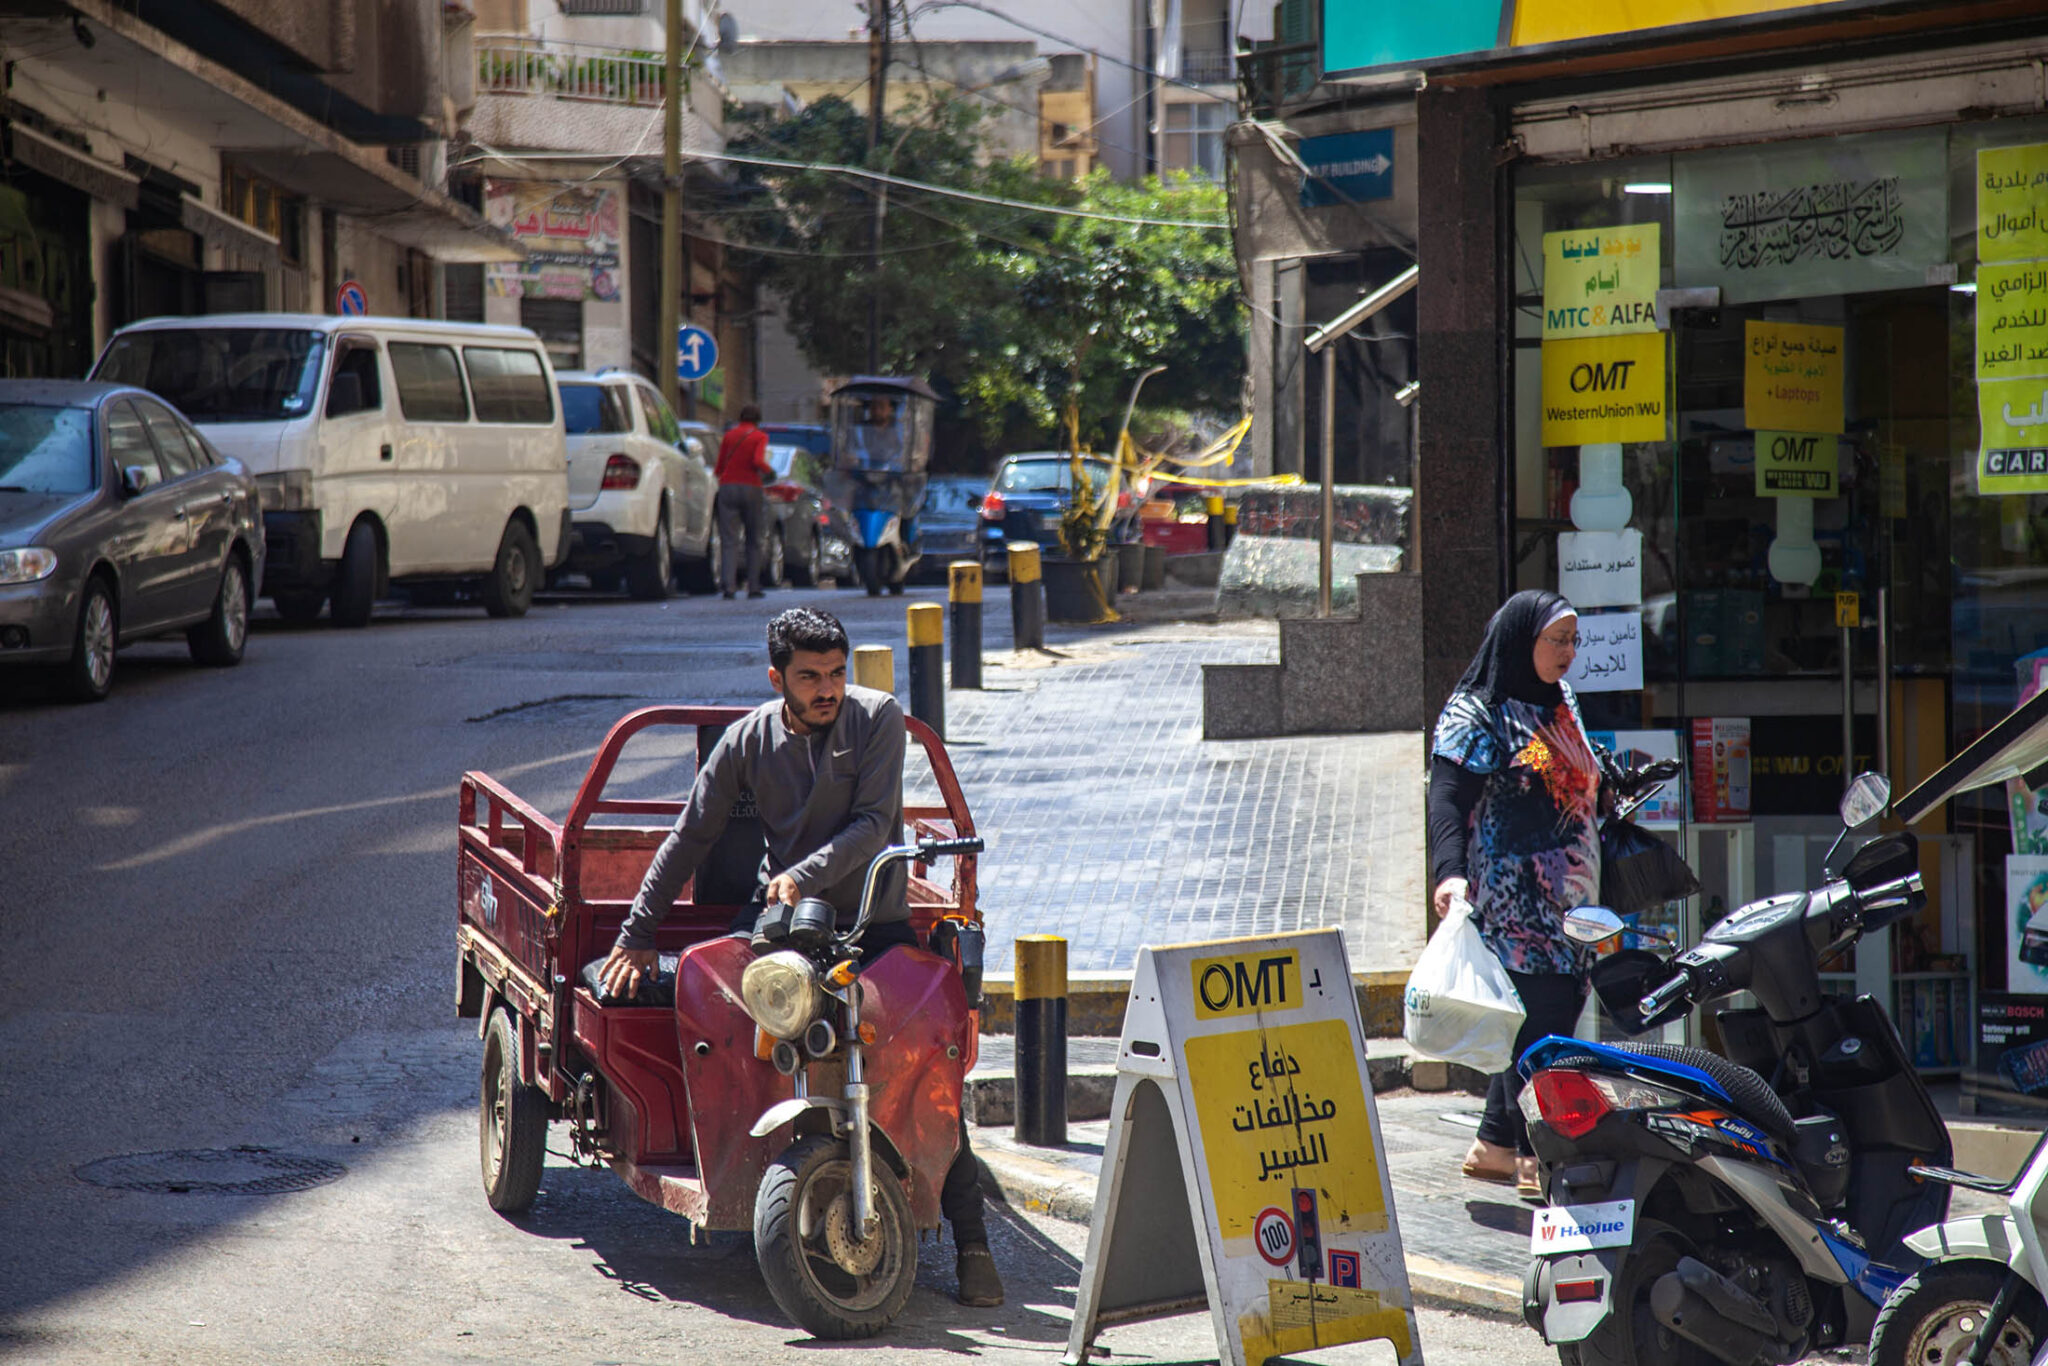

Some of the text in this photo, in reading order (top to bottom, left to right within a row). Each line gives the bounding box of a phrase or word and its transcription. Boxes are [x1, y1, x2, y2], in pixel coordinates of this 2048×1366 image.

[1986, 171, 2027, 193] بلدية
[1986, 204, 2036, 239] أموال
[1562, 236, 1642, 263] يوجد لدينا
[1585, 262, 1620, 298] أيام
[1991, 271, 2047, 303] إلزامي
[1548, 302, 1656, 329] MTC & ALFA
[1992, 309, 2046, 334] للخدم
[1983, 344, 2022, 369] الغير
[1570, 360, 1635, 393] OMT
[1775, 385, 1819, 404] Laptops
[1771, 437, 1819, 462] OMT
[1564, 556, 1636, 573] تصوير مستندات
[1609, 623, 1636, 646] تأمين
[1200, 956, 1293, 1012] OMT
[2007, 1004, 2044, 1018] BOSCH
[1249, 1051, 1300, 1090] دفاع
[1232, 1093, 1336, 1132] مخالفات
[1258, 1133, 1328, 1181] السير
[1262, 1221, 1289, 1253] 100
[1336, 1256, 1353, 1286] P
